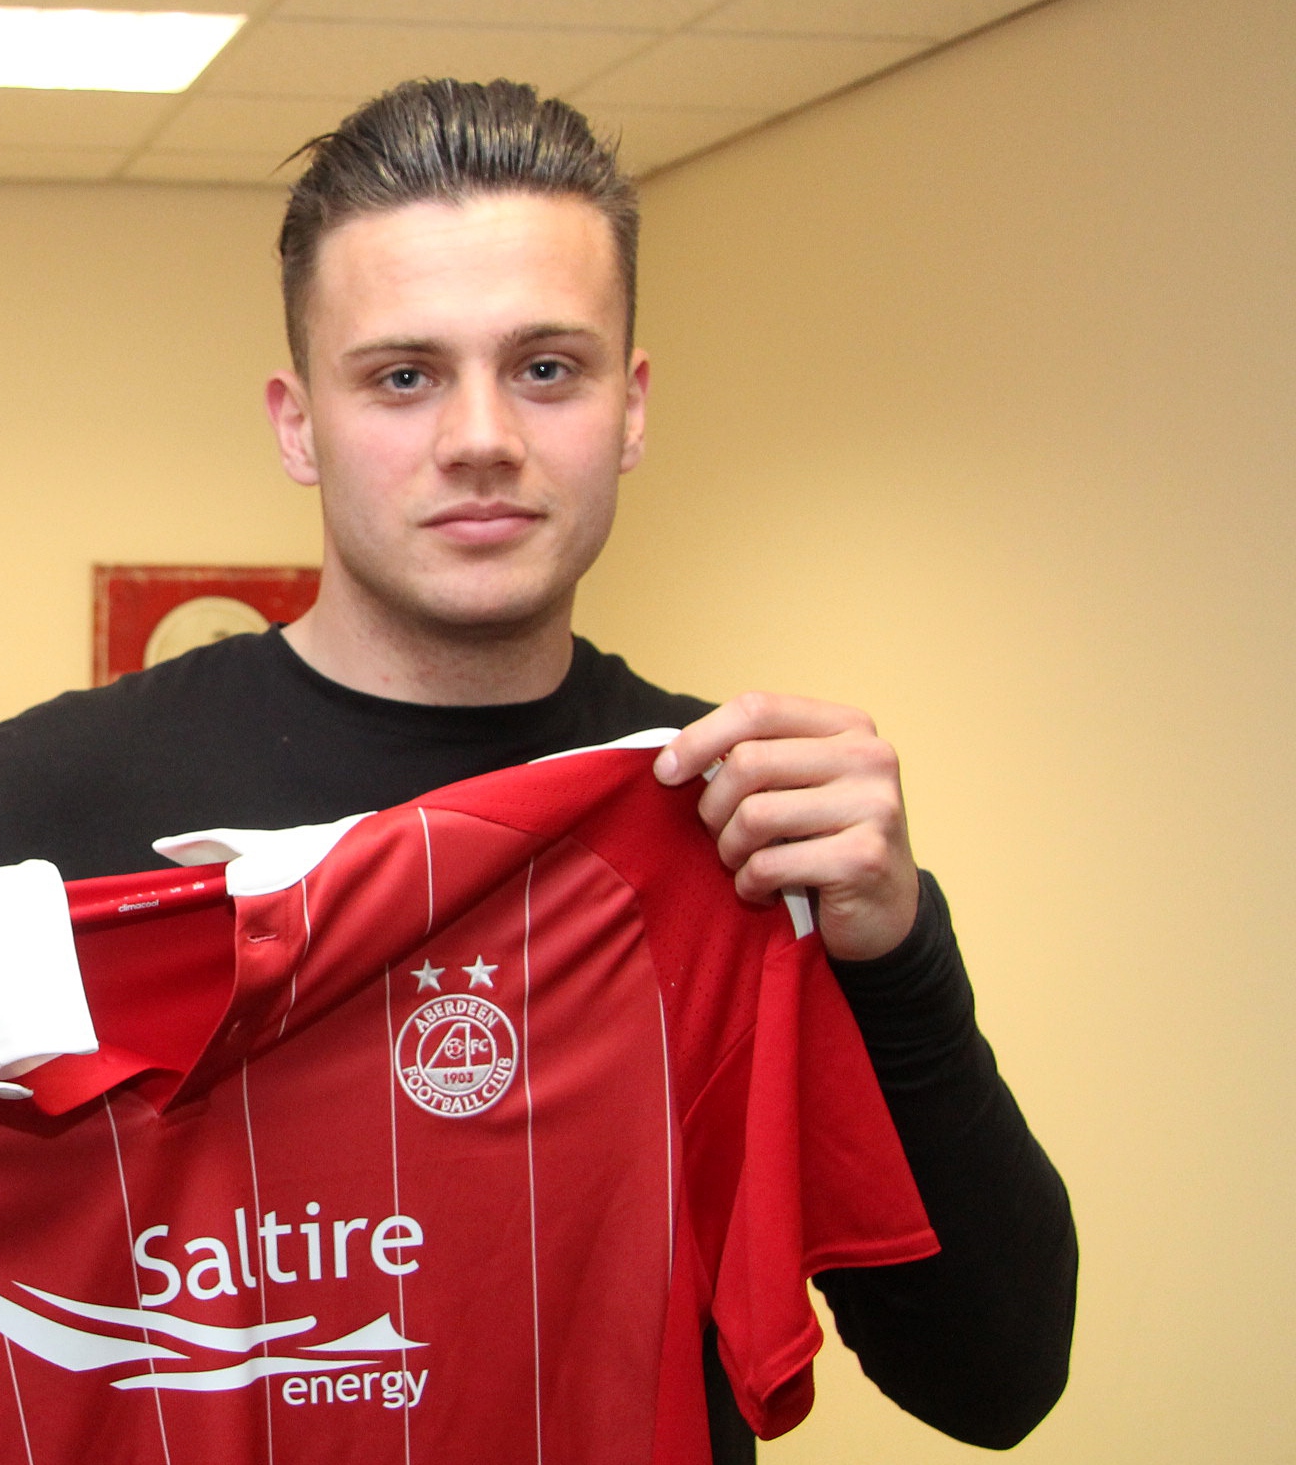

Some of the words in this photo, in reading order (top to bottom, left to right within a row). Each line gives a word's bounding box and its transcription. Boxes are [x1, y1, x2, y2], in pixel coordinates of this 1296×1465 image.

[118, 899, 160, 912] climacool
[414, 1000, 498, 1034] ABERDEEN
[403, 1065, 483, 1113] FOOTBALL
[482, 1057, 512, 1099] CLUB
[443, 1072, 474, 1085] 1903
[134, 1201, 424, 1307] Saltire
[282, 1368, 429, 1409] energy
